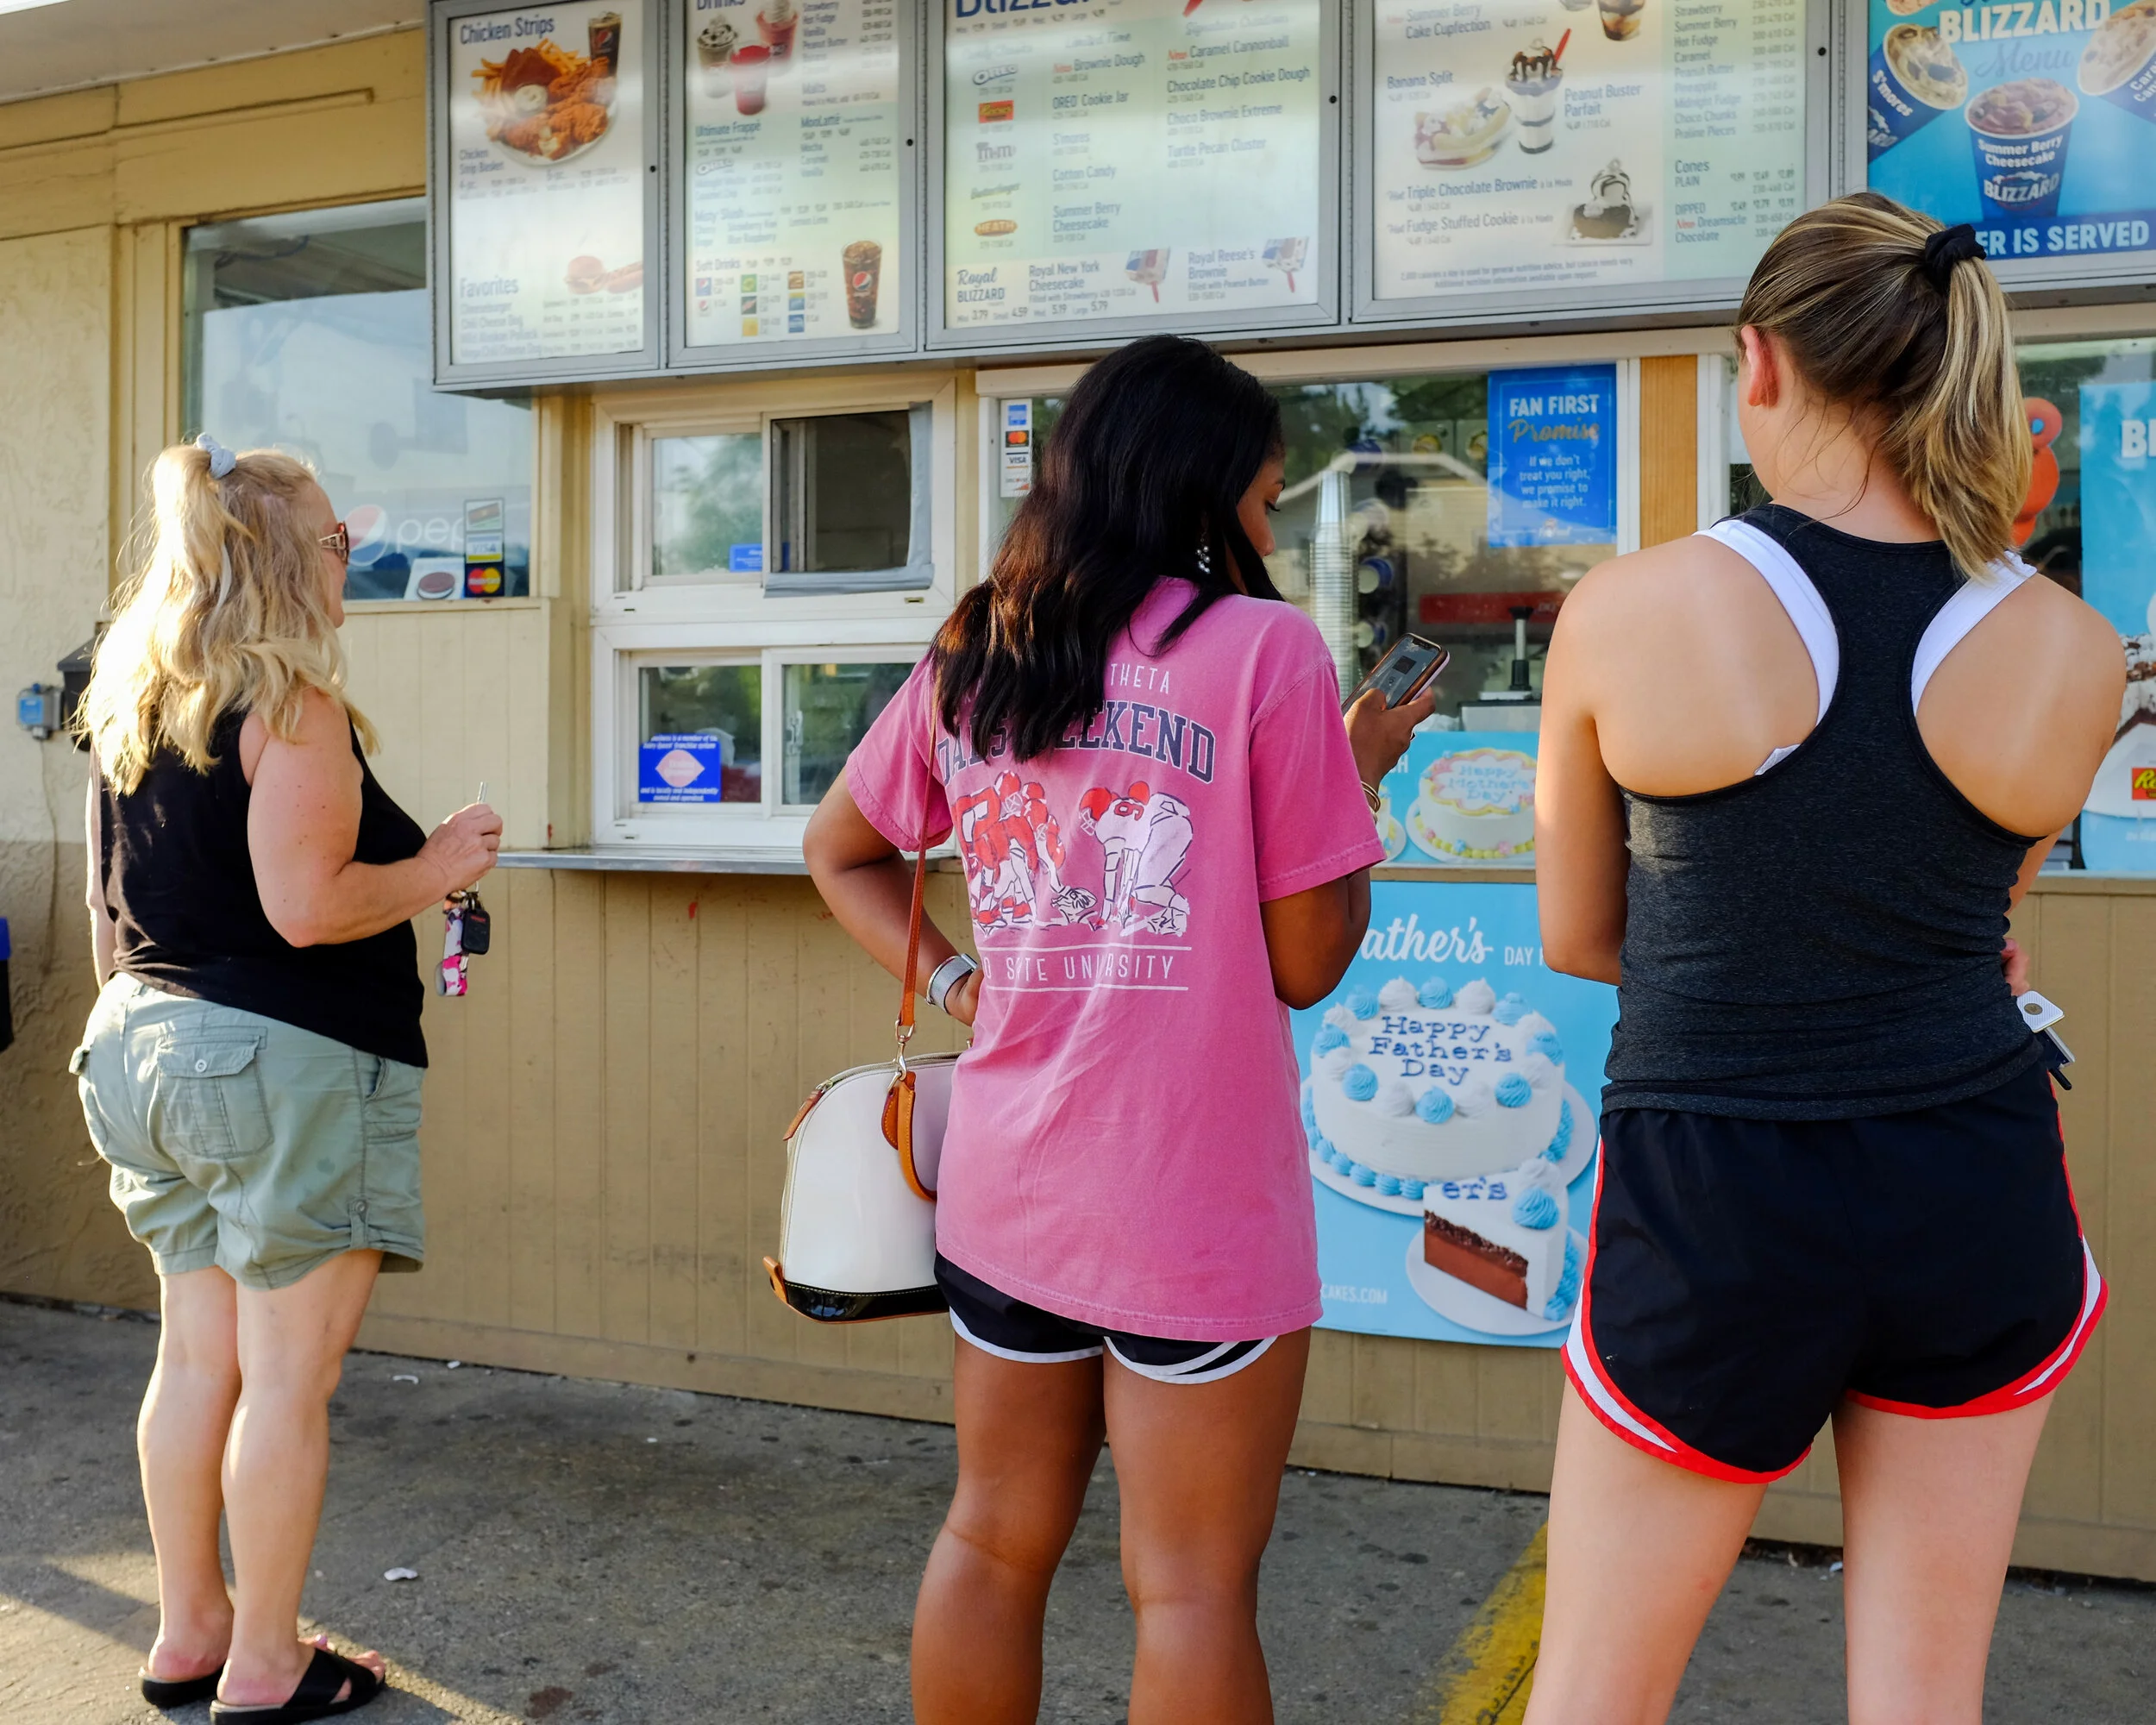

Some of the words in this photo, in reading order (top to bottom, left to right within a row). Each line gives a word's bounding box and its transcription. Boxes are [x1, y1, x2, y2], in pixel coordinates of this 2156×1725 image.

[1406, 7, 1451, 22] Summer
[1453, 3, 1482, 20] Berry
[1675, 5, 1723, 16] Strawberry
[461, 22, 511, 44] Chicken
[515, 15, 555, 37] Strips
[1406, 25, 1431, 39] Cake
[1434, 18, 1492, 37] Cupfection
[1675, 21, 1711, 32] Summer
[1714, 17, 1738, 29] Berry
[1940, 0, 2109, 43] BLIZZARD
[1189, 43, 1230, 58] Caramel
[1233, 35, 1289, 53] Cannonball
[1674, 37, 1689, 47] Hot
[1691, 34, 1718, 47] Fudge
[1075, 56, 1112, 72] Brownie
[1114, 52, 1145, 67] Dough
[1675, 50, 1711, 63] Caramel
[1974, 41, 2073, 77] Menu
[1675, 67, 1705, 77] Peanut
[1708, 64, 1734, 74] Butter
[2130, 60, 2156, 91] Cara
[1167, 78, 1215, 93] Chocolate
[1219, 75, 1240, 89] Chip
[1243, 71, 1275, 85] Cookie
[1278, 66, 1310, 82] Dough
[1388, 76, 1426, 89] Banana
[1429, 70, 1453, 87] Split
[1052, 95, 1078, 110] OREO
[1081, 91, 1112, 106] Cookie
[1115, 90, 1129, 103] Jar
[1564, 87, 1603, 101] Peanut
[1606, 84, 1642, 98] Buster
[1872, 69, 1914, 116] S'mores
[1564, 104, 1601, 117] Parfait
[1675, 97, 1712, 109] Midnight
[1714, 95, 1741, 105] Fudge
[1167, 112, 1197, 125] Choco
[1200, 106, 1238, 122] Brownie
[1242, 104, 1282, 118] Extreme
[1704, 110, 1737, 122] Chunks
[1053, 133, 1090, 146] S'mores
[1675, 128, 1705, 139] Praline
[1707, 125, 1736, 136] Pieces
[1168, 145, 1196, 157] Turtle
[1199, 142, 1228, 154] Pecan
[1232, 138, 1266, 152] Cluster
[1977, 138, 2028, 155] Summer
[2032, 135, 2063, 154] Berry
[1676, 160, 1710, 174] Cones
[1985, 150, 2055, 167] Cheesecake
[1053, 169, 1084, 181] Cotton
[1087, 166, 1116, 179] Candy
[1676, 176, 1700, 187] PLAIN
[1407, 185, 1437, 200] Triple
[1438, 181, 1492, 197] Chocolate
[1495, 176, 1538, 192] Brownie
[1984, 173, 2059, 203] BLIZZARD
[1053, 205, 1093, 218] Summer
[1095, 202, 1121, 216] Berry
[1676, 203, 1706, 215] DIPPED
[1053, 217, 1109, 233] Cheesecake
[1407, 217, 1438, 234] Fudge
[1441, 214, 1480, 230] Stuffed
[1482, 211, 1519, 227] Cookie
[1697, 215, 1747, 228] Dreamsicle
[1676, 231, 1719, 243] Chocolate
[2014, 226, 2040, 253] IS
[2047, 220, 2149, 252] SERVED
[715, 258, 741, 270] Drinks
[1188, 250, 1215, 266] Royal
[1219, 248, 1255, 261] Reese's
[957, 267, 998, 287] Royal
[1029, 264, 1055, 279] Royal
[1057, 262, 1078, 275] New
[1081, 260, 1100, 273] York
[1188, 265, 1227, 279] Brownie
[460, 275, 519, 298] Favorites
[1029, 277, 1084, 292] Cheesecake
[1188, 282, 1209, 291] Filled
[1211, 280, 1222, 290] with
[1224, 279, 1247, 289] Peanut
[1249, 277, 1269, 287] Butter
[957, 287, 1005, 303] BLIZZARD
[1029, 294, 1046, 303] Filled
[1048, 293, 1061, 302] with
[1062, 292, 1099, 303] Strawberry
[1012, 306, 1028, 317] 4.59
[1052, 304, 1067, 315] 5.19
[1091, 300, 1108, 313] 5.79
[1510, 397, 1543, 417] FAN
[1548, 394, 1600, 416] FIRST
[1508, 417, 1600, 443] Promise
[1529, 456, 1538, 467] If
[1539, 458, 1552, 467] we
[1555, 455, 1580, 467] don't
[1520, 471, 1542, 481] treat
[1545, 472, 1562, 484] you
[1564, 468, 1590, 482] right,
[1521, 486, 1535, 495] we
[1538, 483, 1575, 496] promise
[1578, 482, 1588, 492] to
[1522, 496, 1548, 509] make
[1551, 497, 1557, 508] it
[1561, 495, 1586, 510] right.
[469, 541, 497, 554] VISA
[1110, 662, 1170, 694] THETA
[1459, 765, 1517, 779] Happy
[1448, 777, 1530, 791] Mother's
[1467, 789, 1507, 804] Day
[1360, 913, 1493, 964] ather's
[1504, 945, 1533, 966] DAY
[1382, 1015, 1490, 1044] Happy
[1368, 1036, 1513, 1063] Father's
[1400, 1058, 1470, 1086] Day
